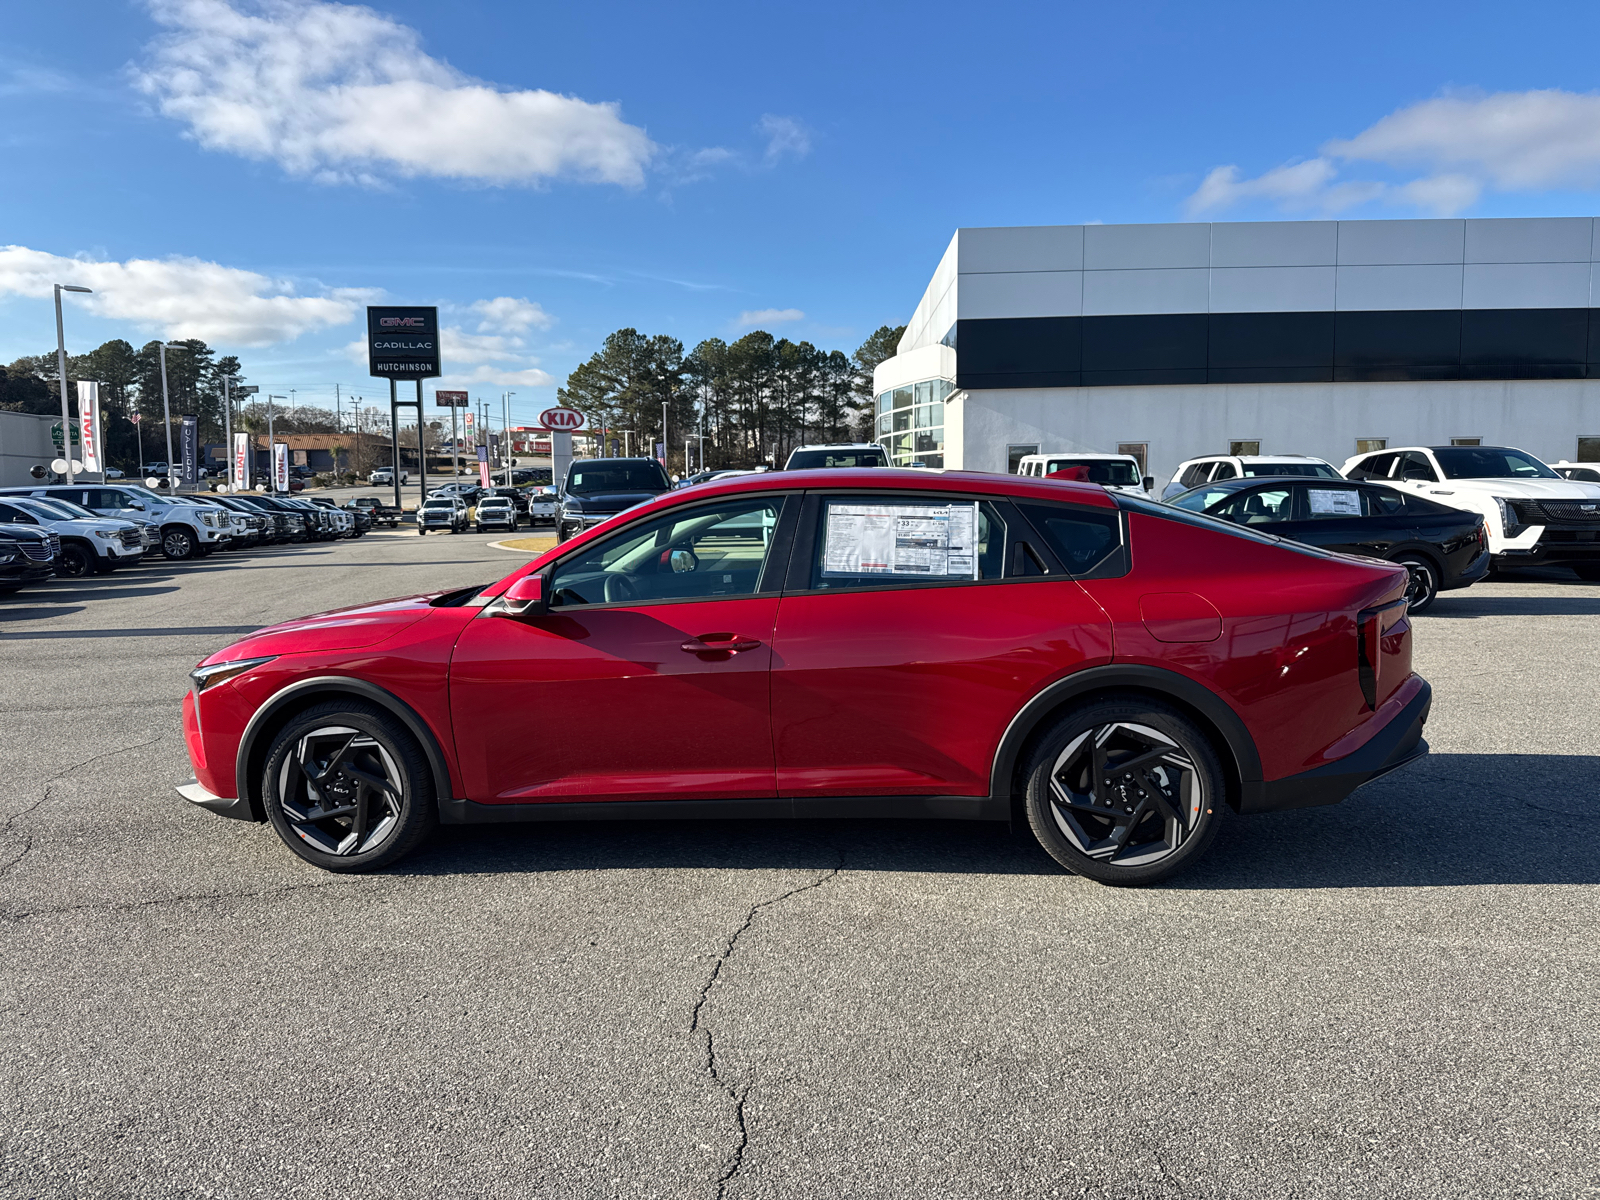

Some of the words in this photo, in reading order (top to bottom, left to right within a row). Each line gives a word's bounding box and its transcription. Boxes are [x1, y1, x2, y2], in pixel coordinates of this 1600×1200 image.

[380, 317, 425, 327] GMC
[377, 363, 432, 371] HUTCHINSON
[547, 412, 578, 426] KIA
